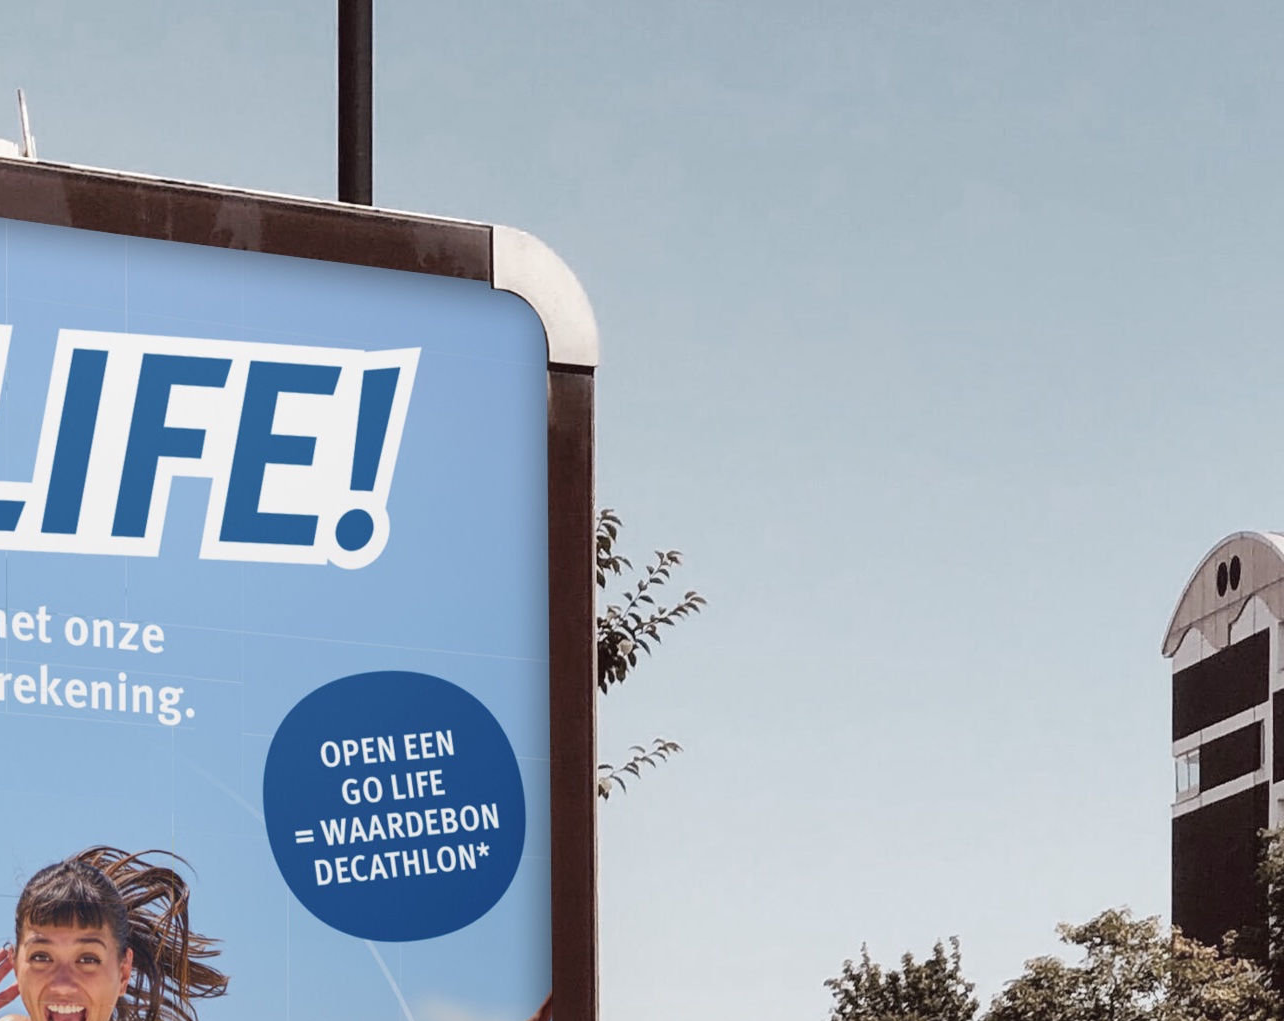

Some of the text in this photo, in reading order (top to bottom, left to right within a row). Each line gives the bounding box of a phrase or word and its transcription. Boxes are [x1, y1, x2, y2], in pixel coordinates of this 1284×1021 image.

[65, 617, 165, 653] onze
[320, 730, 455, 767] OPEN EEN
[342, 769, 446, 805] GO LIFE
[320, 803, 500, 846] WAARDEBON
